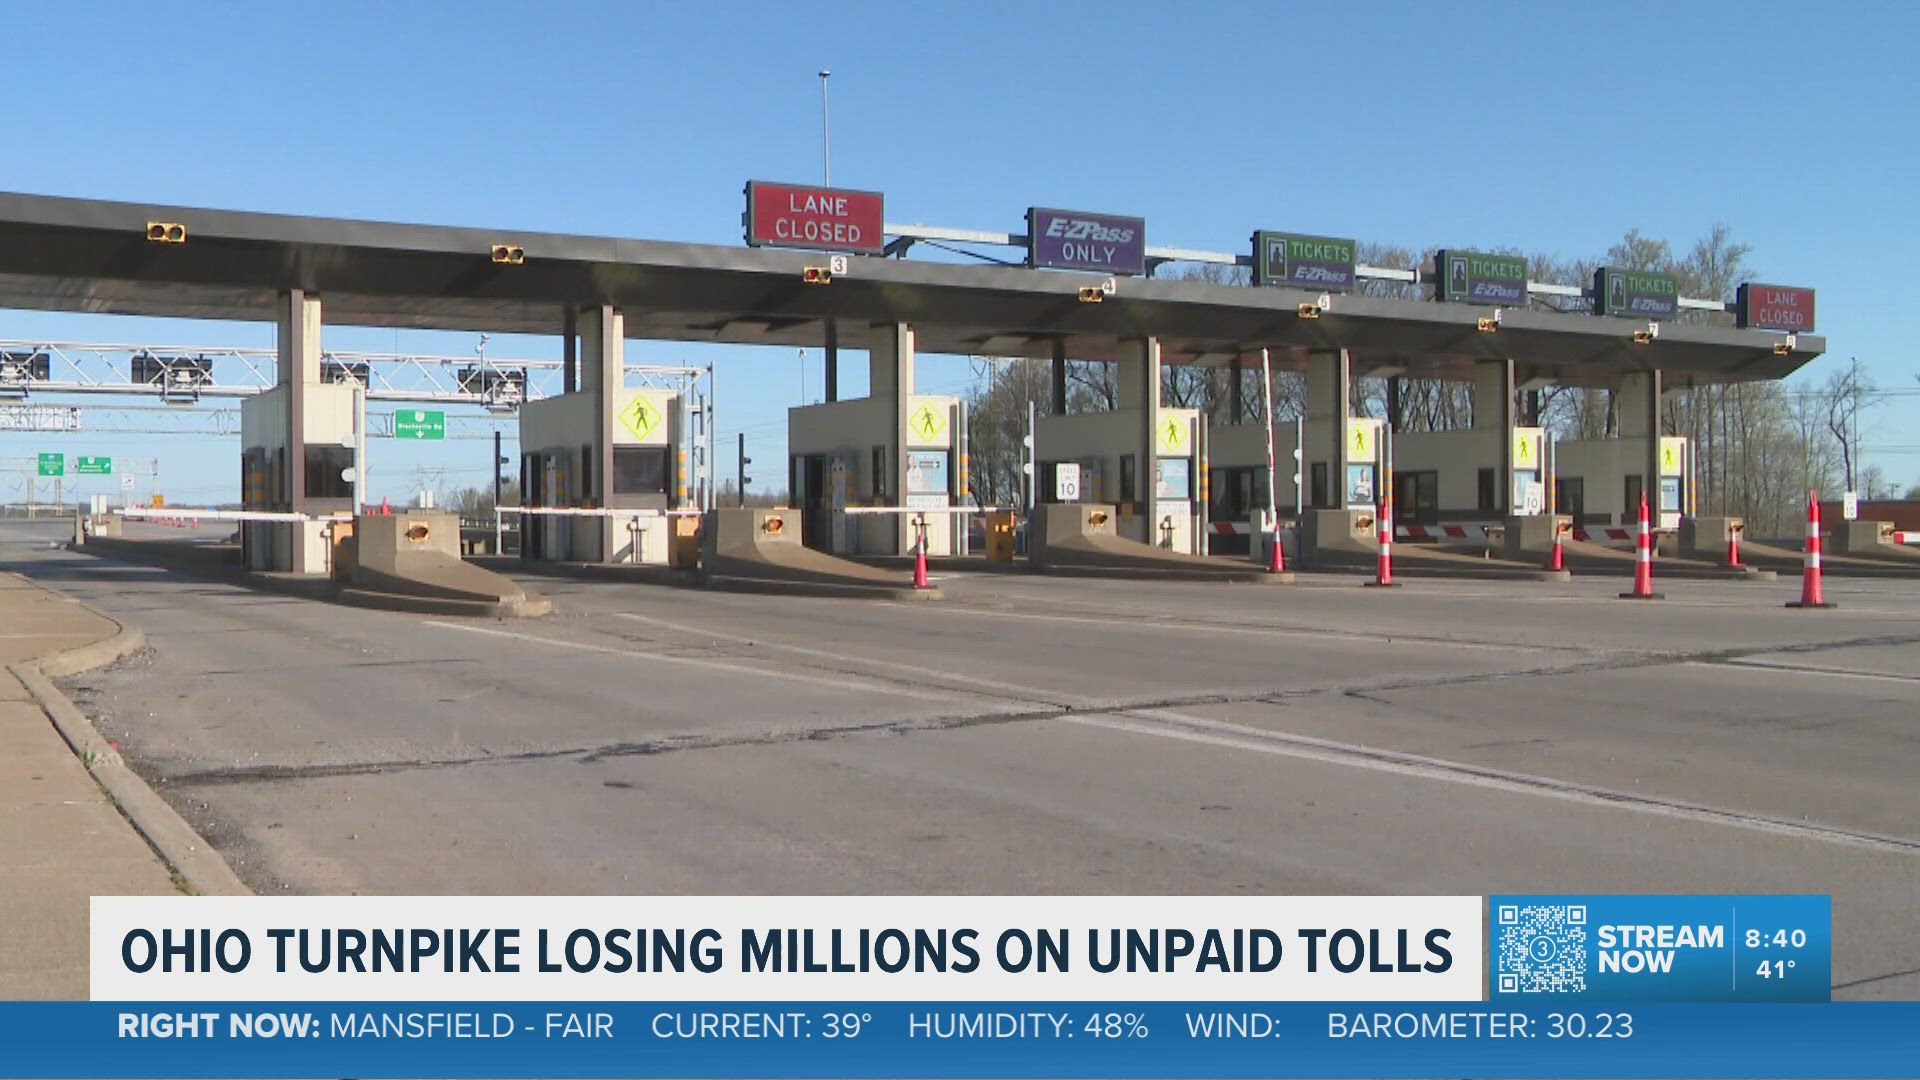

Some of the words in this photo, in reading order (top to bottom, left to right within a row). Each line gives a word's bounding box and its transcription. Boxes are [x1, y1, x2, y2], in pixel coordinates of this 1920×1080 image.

[790, 193, 848, 217] LANE
[775, 218, 861, 243] CLOSED
[1062, 243, 1115, 264] ONLY
[1291, 241, 1350, 261] TICKETS
[834, 256, 844, 272] 3
[1471, 261, 1523, 280] TICKETS
[1104, 278, 1114, 292] 4
[1629, 276, 1674, 295] TICKETS
[1767, 291, 1797, 307] LANE
[1760, 309, 1804, 326] CLOSED
[1061, 482, 1075, 496] 10
[1527, 497, 1538, 509] 10
